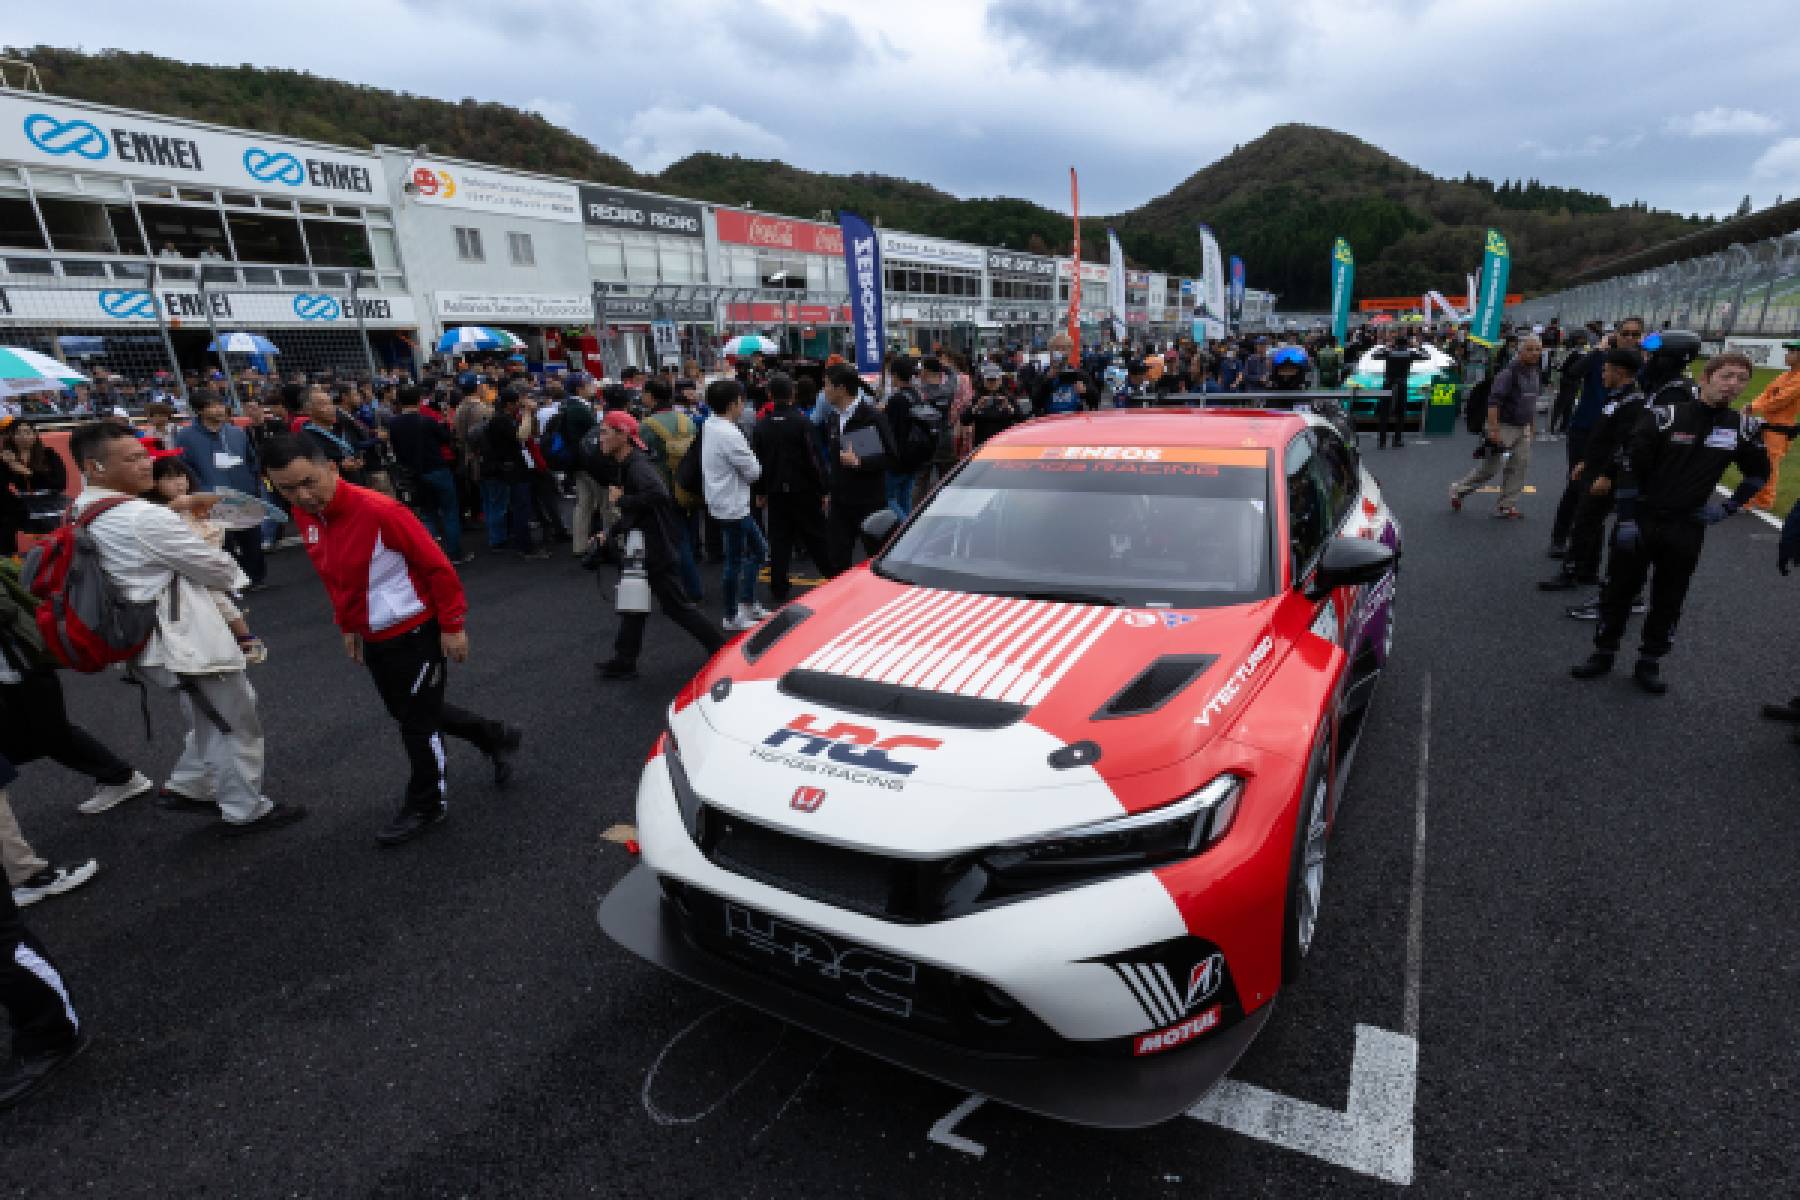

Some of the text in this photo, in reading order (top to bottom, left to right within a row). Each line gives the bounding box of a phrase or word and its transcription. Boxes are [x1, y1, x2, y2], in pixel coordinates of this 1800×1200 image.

[110, 128, 203, 171] ENKEI
[305, 158, 372, 193] ENKEI
[1064, 446, 1162, 461] ENEOS
[1092, 462, 1220, 477] RACING
[1193, 635, 1274, 727] VTEC TURBO
[762, 713, 945, 776] HRC
[820, 763, 907, 792] RACING
[1138, 1010, 1216, 1054] MOTUL
